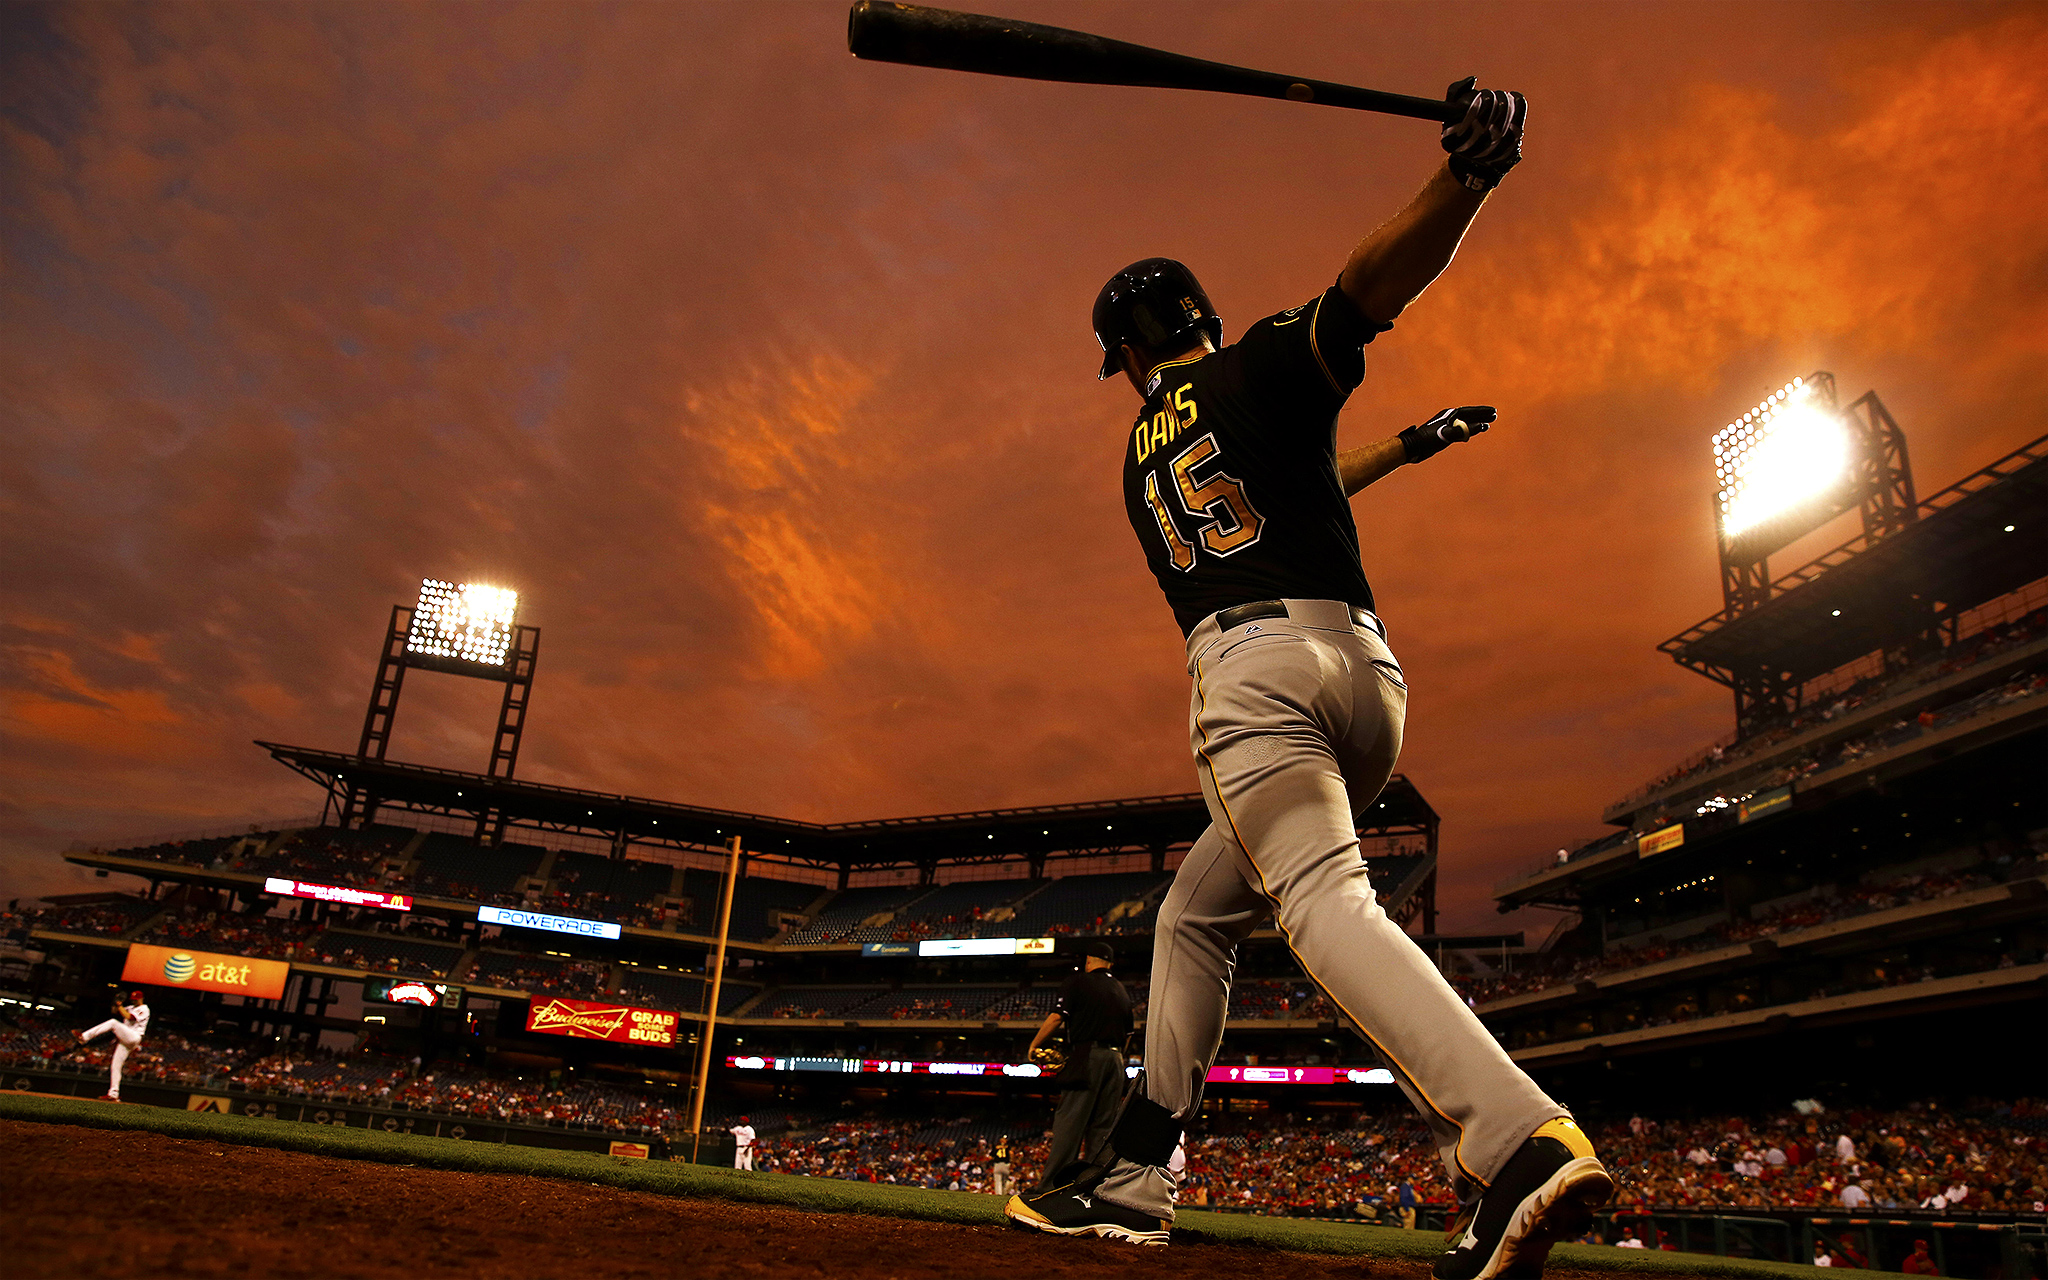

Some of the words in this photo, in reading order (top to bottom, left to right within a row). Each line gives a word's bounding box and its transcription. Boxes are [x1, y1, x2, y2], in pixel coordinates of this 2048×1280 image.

[1465, 173, 1486, 191] 15
[1180, 296, 1195, 311] 15
[1135, 382, 1199, 465] DAVIS
[1144, 432, 1266, 573] 15
[497, 910, 604, 935] POWERADE
[199, 962, 252, 986] at&t
[532, 1004, 625, 1029] Budweiser
[631, 1011, 675, 1026] GRAB
[637, 1022, 666, 1032] SOME
[628, 1028, 672, 1043] BUDS
